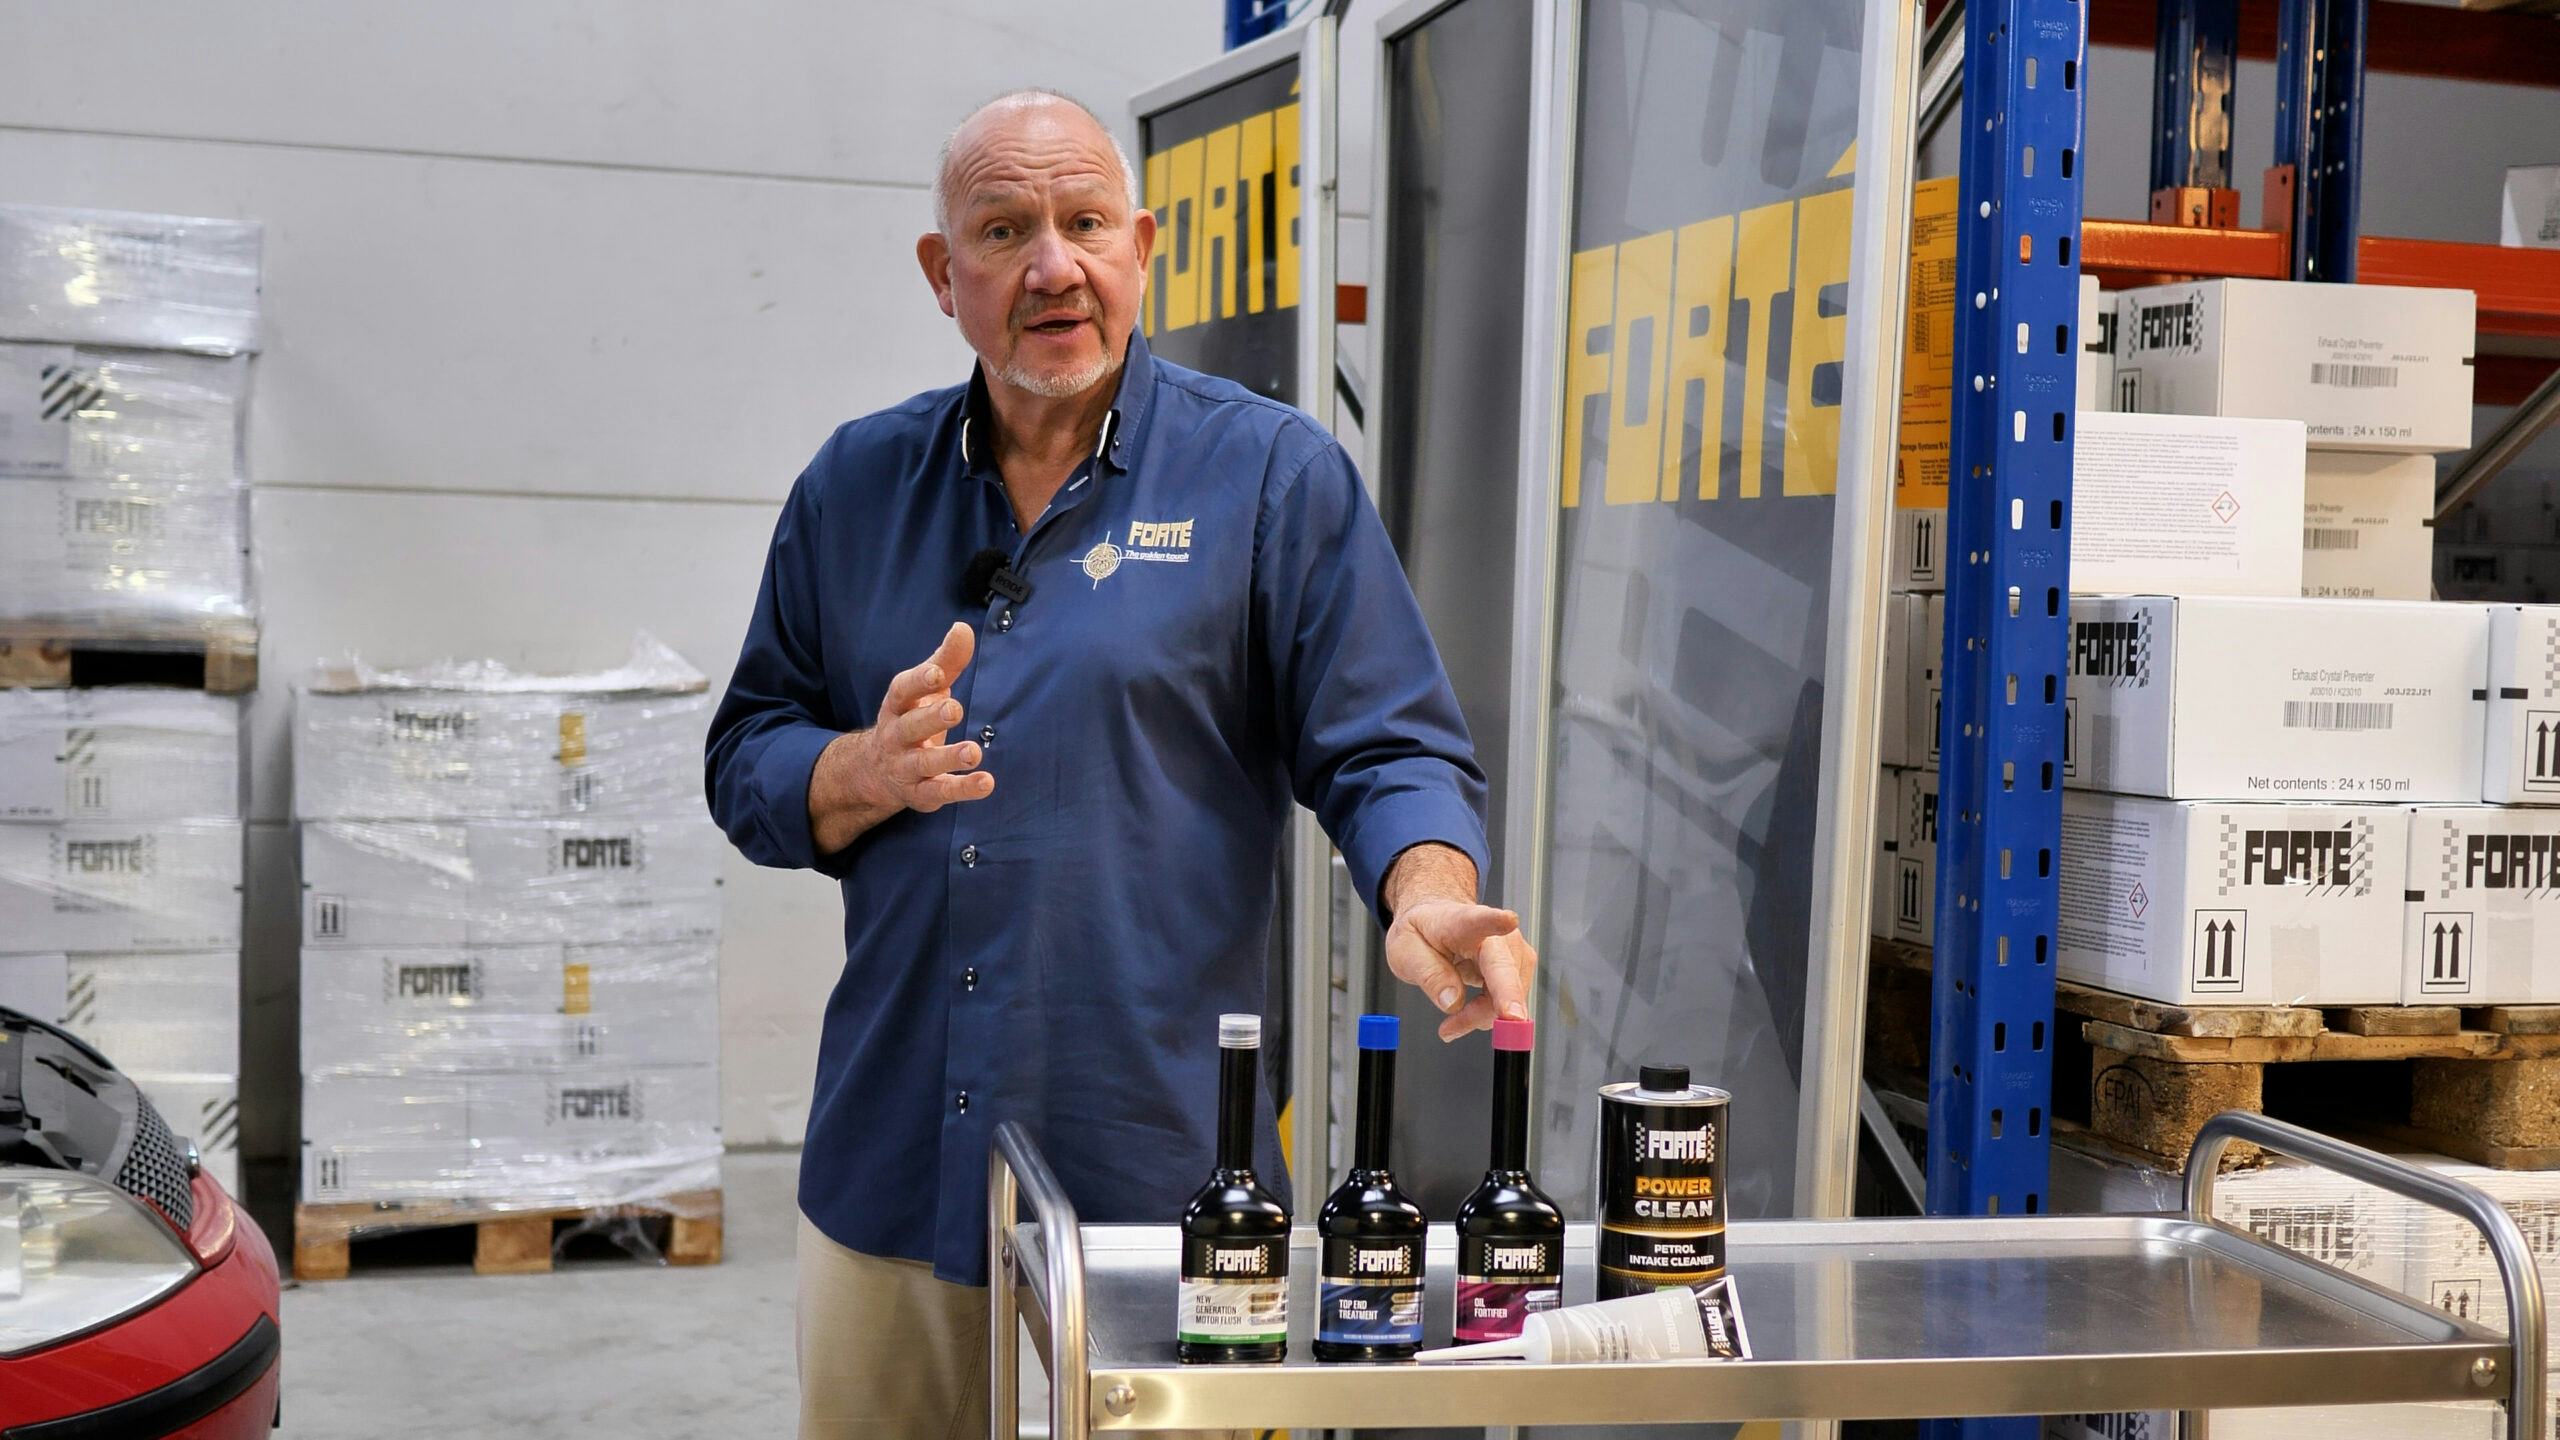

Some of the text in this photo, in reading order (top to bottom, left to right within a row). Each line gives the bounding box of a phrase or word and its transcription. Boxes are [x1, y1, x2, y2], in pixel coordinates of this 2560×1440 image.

[2141, 295, 2193, 350] FORTÉ
[2307, 424, 2344, 436] ontents
[2354, 425, 2366, 437] 24
[2379, 427, 2397, 438] 150
[2399, 427, 2412, 437] ml
[2318, 586, 2330, 596] 24
[2362, 587, 2374, 597] ml
[2075, 611, 2139, 676] FORTÉ
[2292, 668, 2375, 684] Exhaust Crystal Preventer
[2248, 777, 2269, 790] Net
[2273, 778, 2327, 790] contents
[2339, 778, 2354, 790] 24
[2358, 781, 2365, 790] x
[2370, 778, 2391, 791] 150
[2395, 778, 2410, 790] ml
[2244, 820, 2352, 885] FORTÉ
[1648, 1125, 1708, 1160] FORTÉ
[1634, 1176, 1713, 1196] POWER
[1634, 1200, 1713, 1218] CLEAN
[1654, 1243, 1696, 1255] PETROL
[1215, 1246, 1261, 1272] FORTÉ
[1358, 1246, 1404, 1272] FORTÉ
[1493, 1244, 1538, 1270] FORTÉ
[1629, 1255, 1715, 1267] INTAKE CLEANER
[1196, 1295, 1212, 1304] NEW
[1339, 1299, 1368, 1310] TOP END
[1474, 1298, 1486, 1308] OIL
[1195, 1305, 1237, 1315] GENERATION
[1339, 1310, 1378, 1320] TREATMENT
[1474, 1308, 1508, 1318] FORTIFIER
[1195, 1315, 1242, 1326] MOTOR FLUSH
